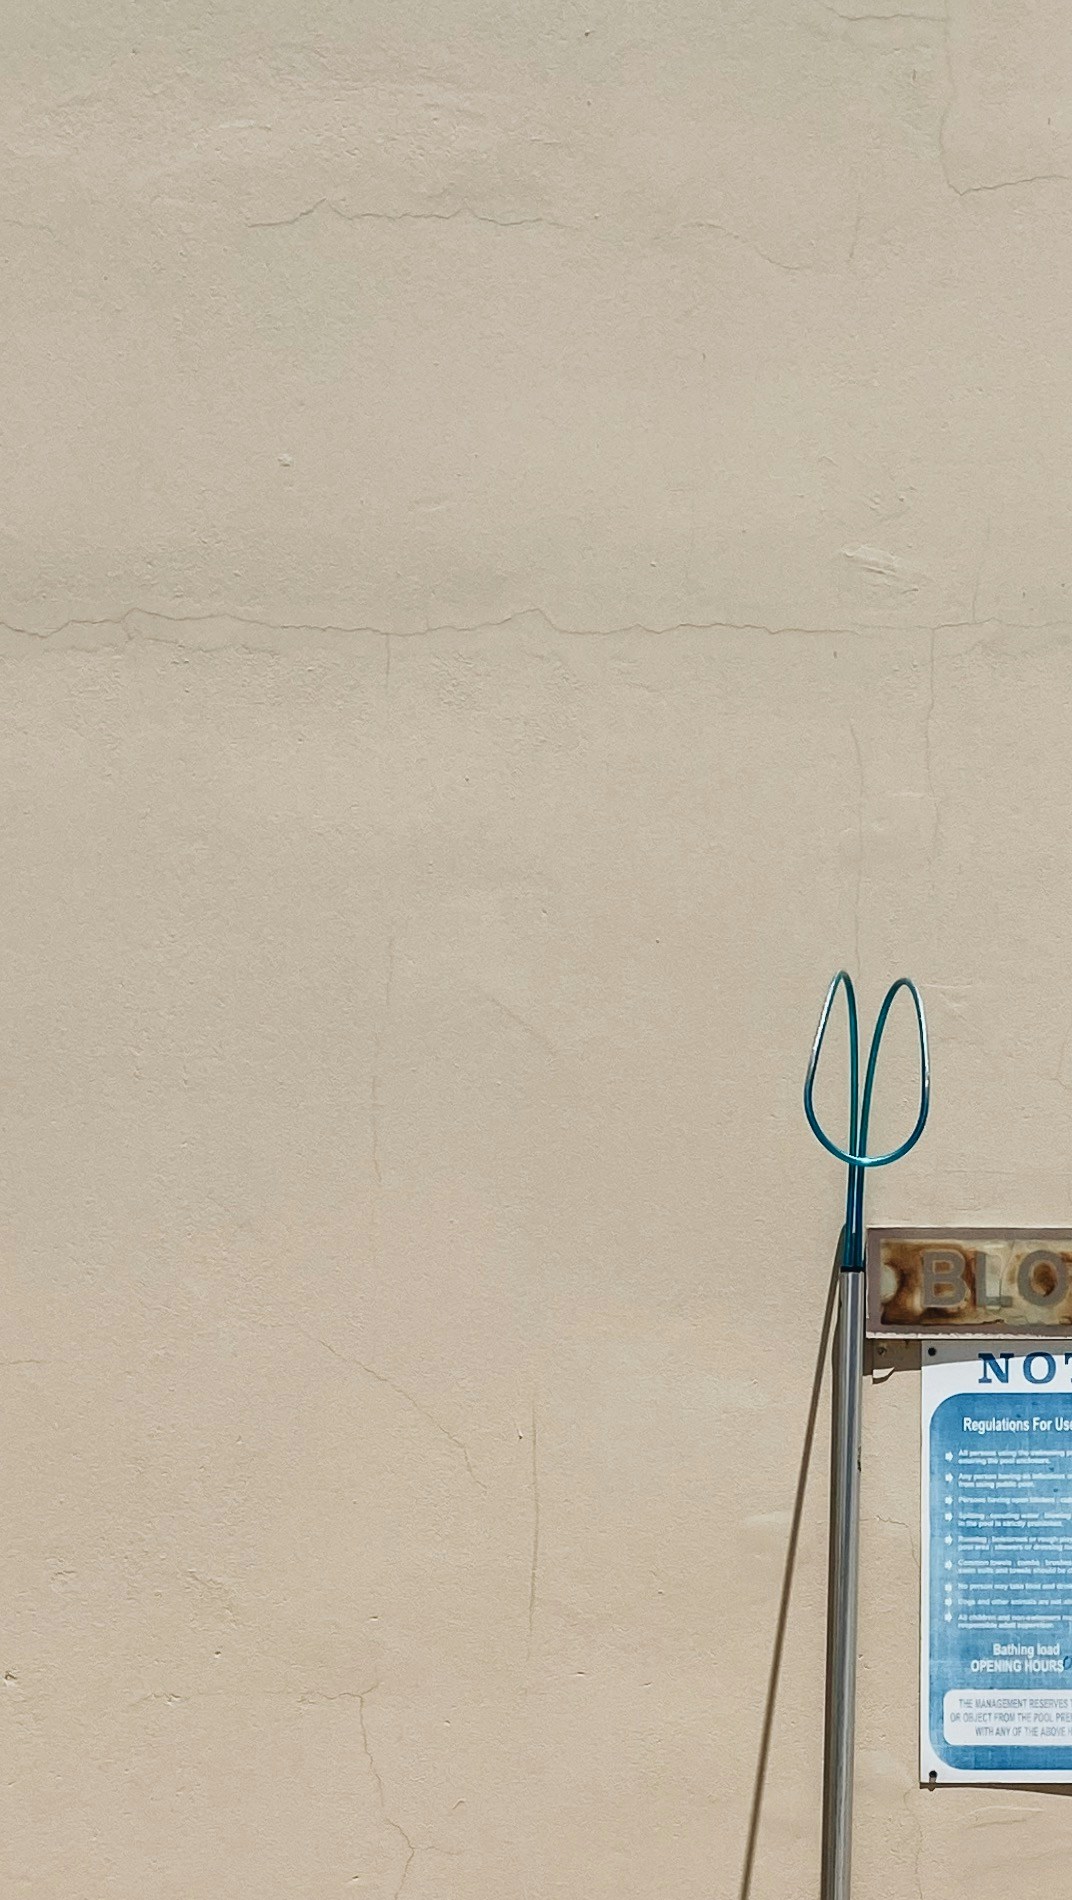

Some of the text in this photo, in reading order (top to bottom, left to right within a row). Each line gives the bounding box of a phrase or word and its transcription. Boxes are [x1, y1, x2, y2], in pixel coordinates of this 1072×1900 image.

[963, 1416, 1030, 1434] Regulations
[1032, 1417, 1053, 1431] For
[993, 1643, 1035, 1659] Bathing
[1036, 1643, 1060, 1655] load
[970, 1659, 1022, 1672] OPENING
[1024, 1659, 1064, 1673] HOURS
[959, 1698, 973, 1709] THE
[975, 1698, 1027, 1709] MANAGEMENT
[1029, 1698, 1068, 1709] RESERVES
[950, 1712, 961, 1723] OR
[993, 1712, 1016, 1723] FROM
[1017, 1712, 1032, 1723] THE
[1033, 1712, 1054, 1723] POOL
[975, 1726, 994, 1737] WITH
[994, 1726, 1011, 1737] ANY
[1012, 1726, 1022, 1737] OF
[1023, 1726, 1038, 1737] THE
[1040, 1726, 1066, 1737] ABOVE
